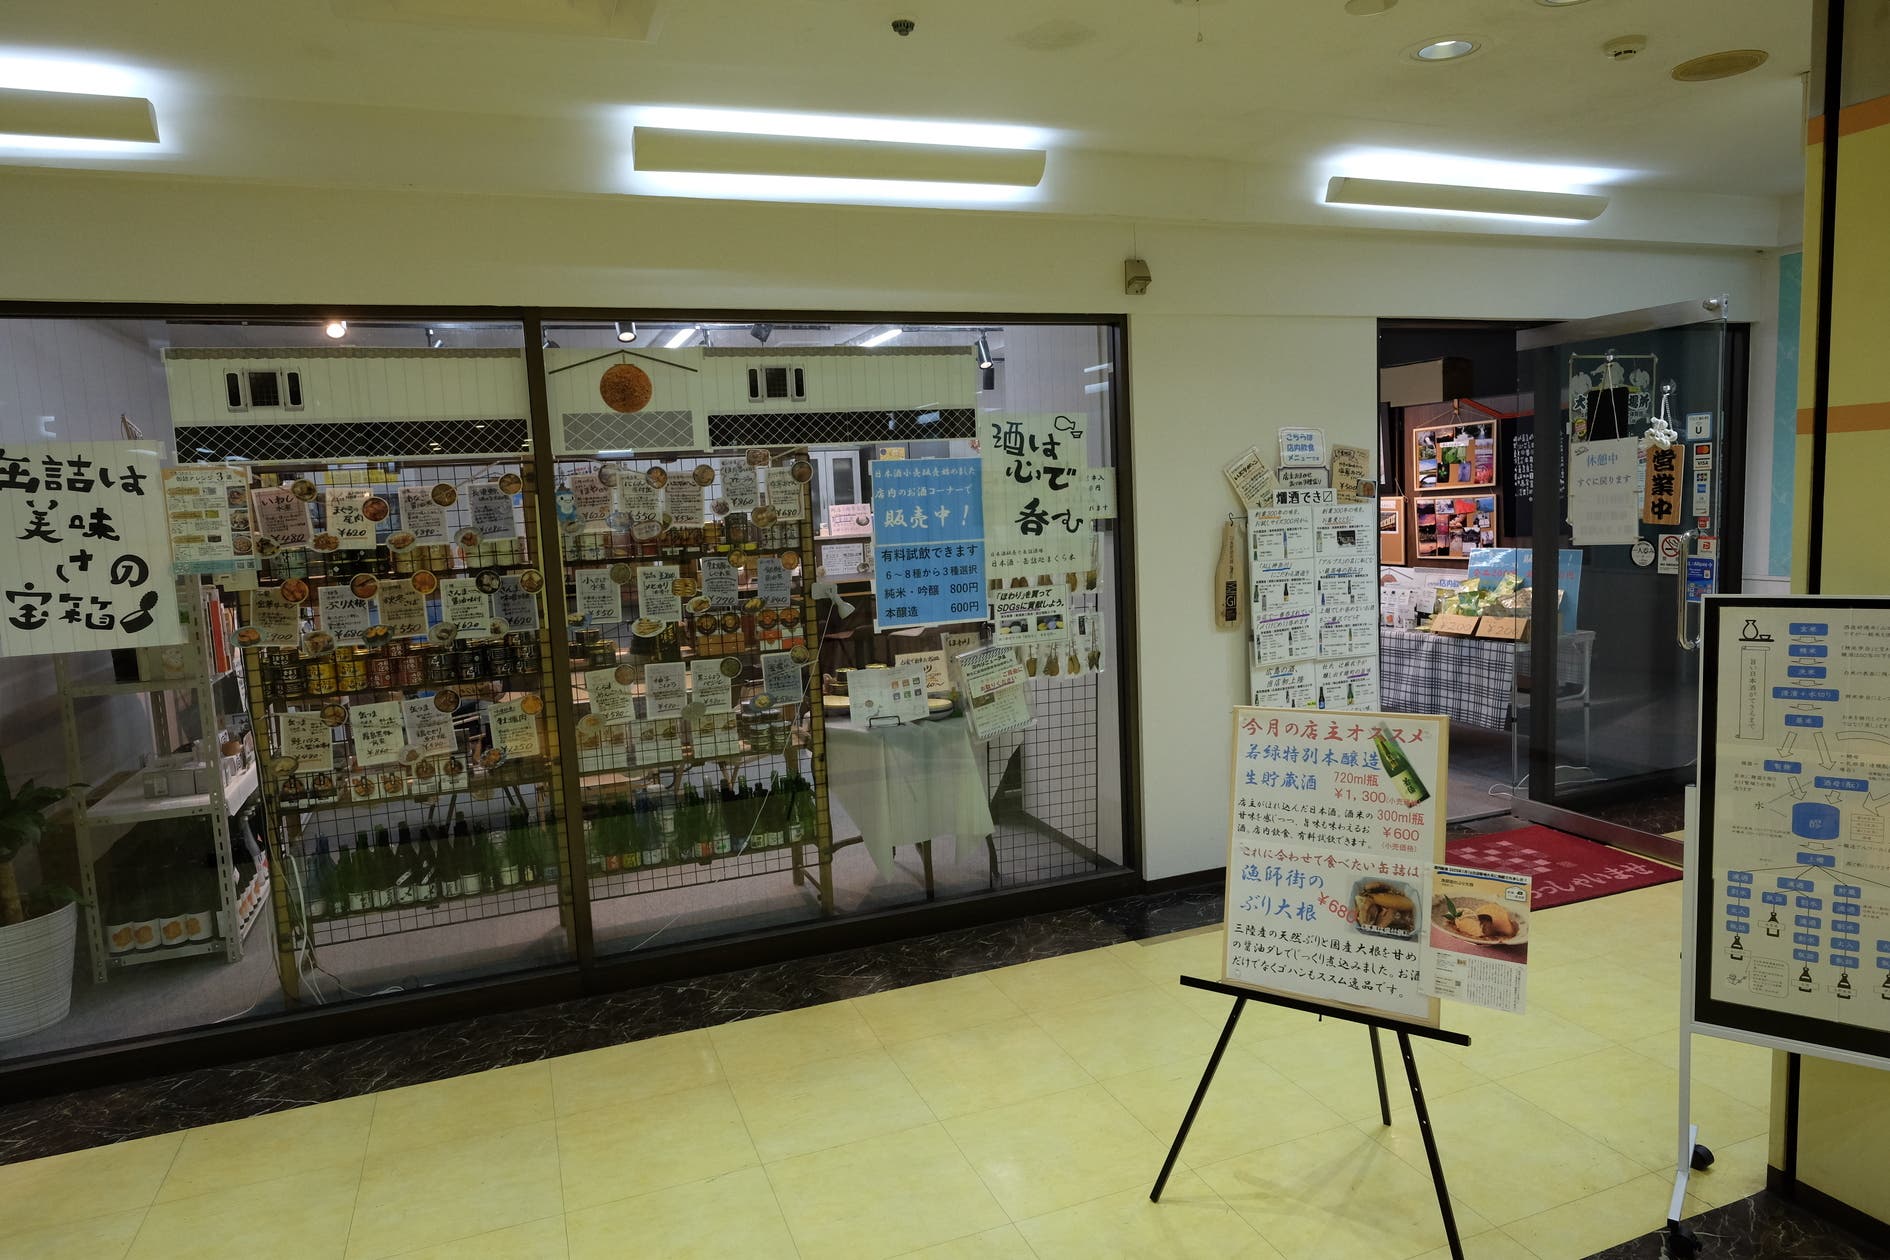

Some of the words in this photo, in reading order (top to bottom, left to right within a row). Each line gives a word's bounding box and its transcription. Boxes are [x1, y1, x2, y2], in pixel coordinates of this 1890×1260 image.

[991, 421, 1061, 460] 酒は
[1586, 453, 1619, 467] 休憩中
[1006, 460, 1077, 491] 心で
[1576, 475, 1632, 487] すぐに戻ります
[1651, 450, 1675, 520] 営業中
[875, 485, 973, 499] 店内のお酒コーナーで
[16, 499, 120, 543] 美味
[884, 505, 969, 529] 販売中!
[1015, 497, 1084, 536] 呑む
[337, 529, 367, 538] ¥620
[881, 545, 978, 562] 有料試飲できます
[56, 549, 149, 588] さの
[950, 582, 979, 594] 800円
[6, 582, 115, 631] 宝箱
[885, 606, 919, 619] 本醸造
[950, 601, 979, 613] 600円
[1242, 717, 1425, 744] 今月の店主オススメ
[1245, 744, 1382, 772] 若緑特別本醸造
[1245, 770, 1317, 790] 生貯蔵酒
[1334, 771, 1379, 787] 720ml瓶
[1377, 810, 1424, 826] 300ml瓶
[1383, 826, 1420, 841] ¥600
[1242, 846, 1420, 878] これに合わせて食べたい缶詰は
[1241, 864, 1324, 890] 漁師街の
[1240, 895, 1317, 922] ぶり大根
